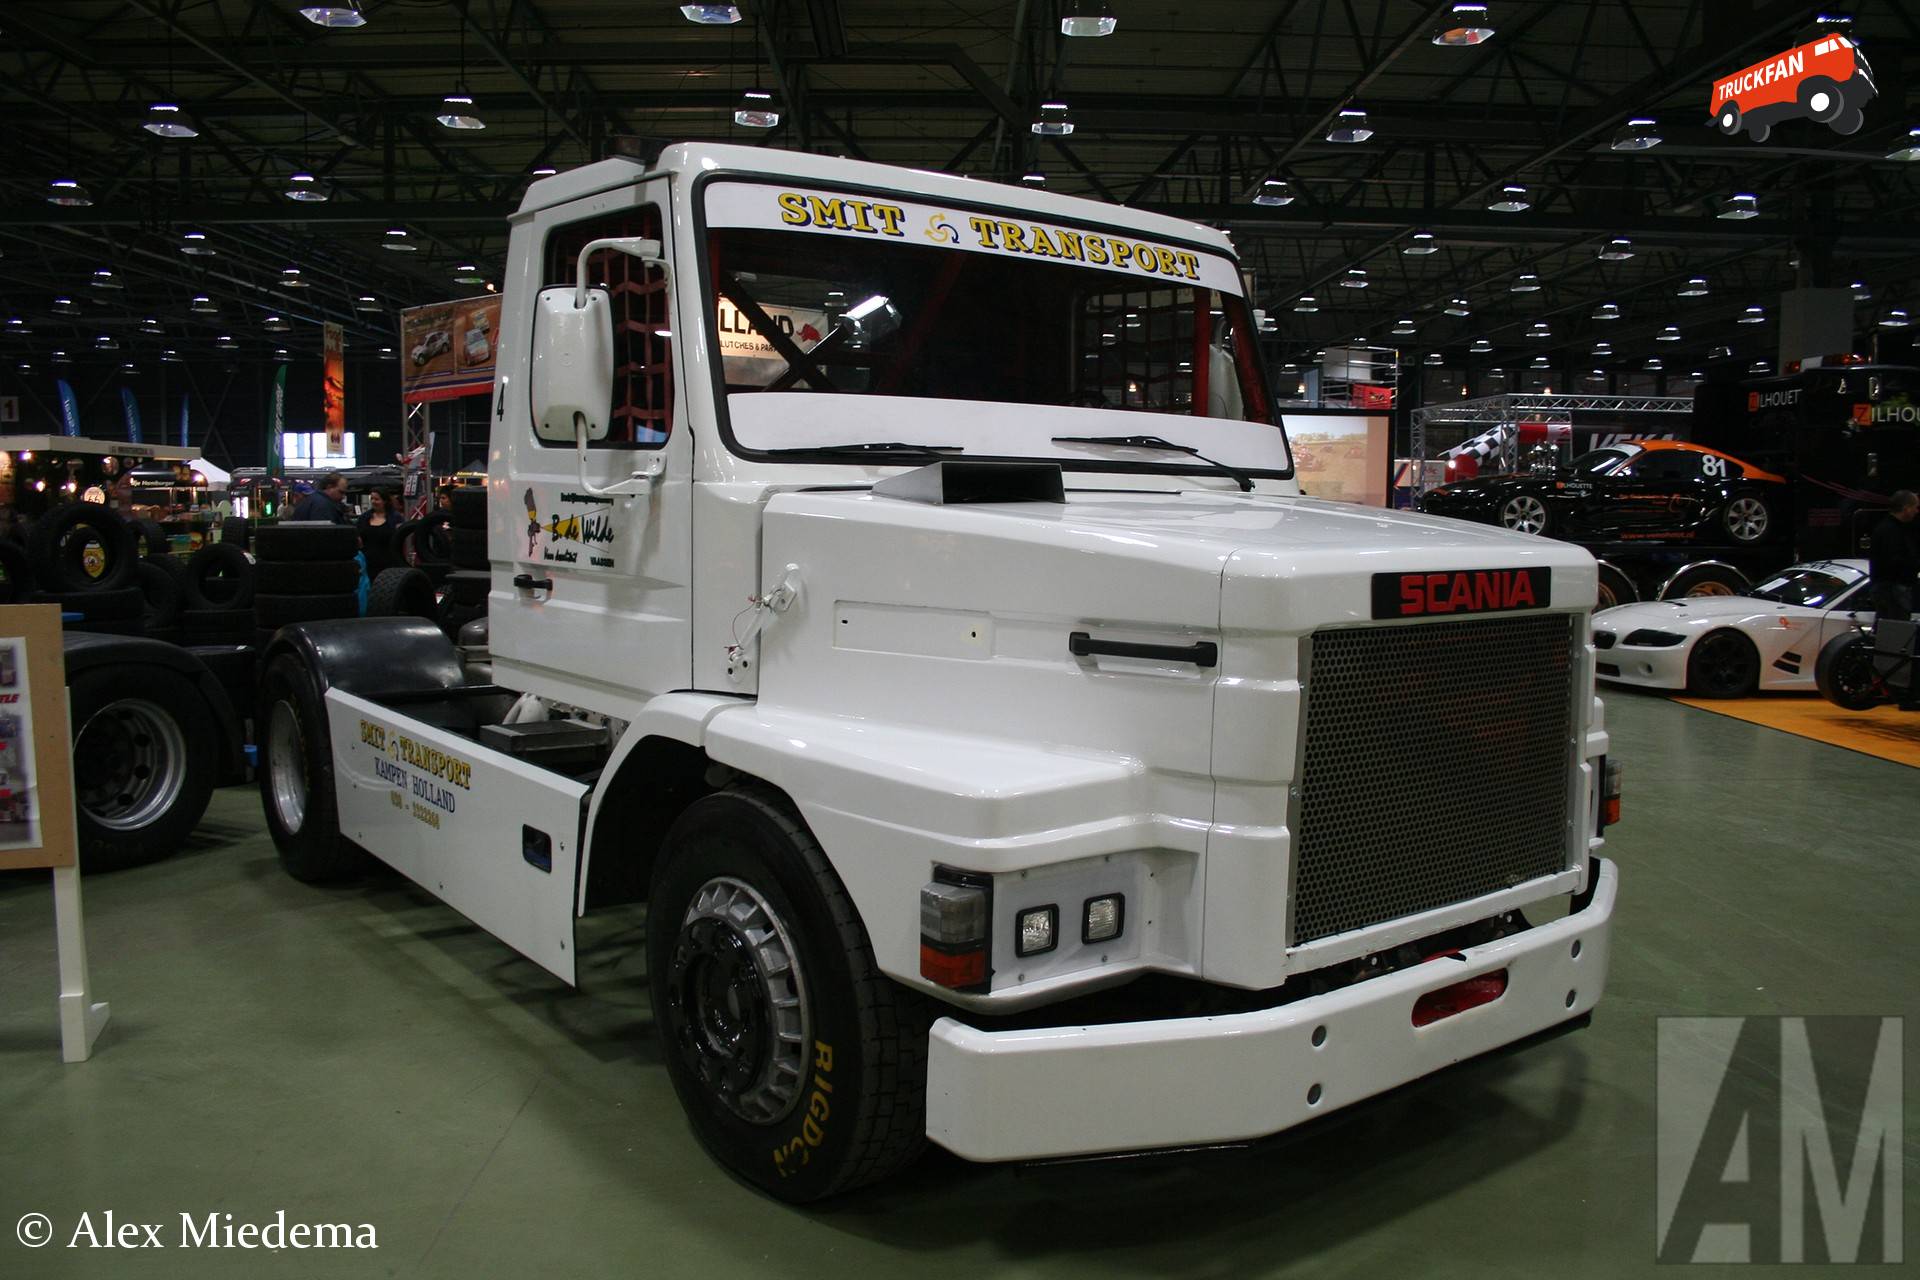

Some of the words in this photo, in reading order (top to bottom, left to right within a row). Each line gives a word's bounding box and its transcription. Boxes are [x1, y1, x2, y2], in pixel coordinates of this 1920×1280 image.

[777, 191, 905, 237] SMIT
[969, 216, 1201, 281] TRANSPORT
[720, 309, 794, 339] LLD
[1702, 454, 1727, 477] 81
[582, 515, 614, 544] Wilde
[1400, 570, 1537, 615] SCANIA
[359, 719, 386, 751] SMIT
[399, 736, 472, 790] TRANSPORT
[374, 757, 408, 790] KAMPEN
[411, 775, 456, 814] HOLLAND
